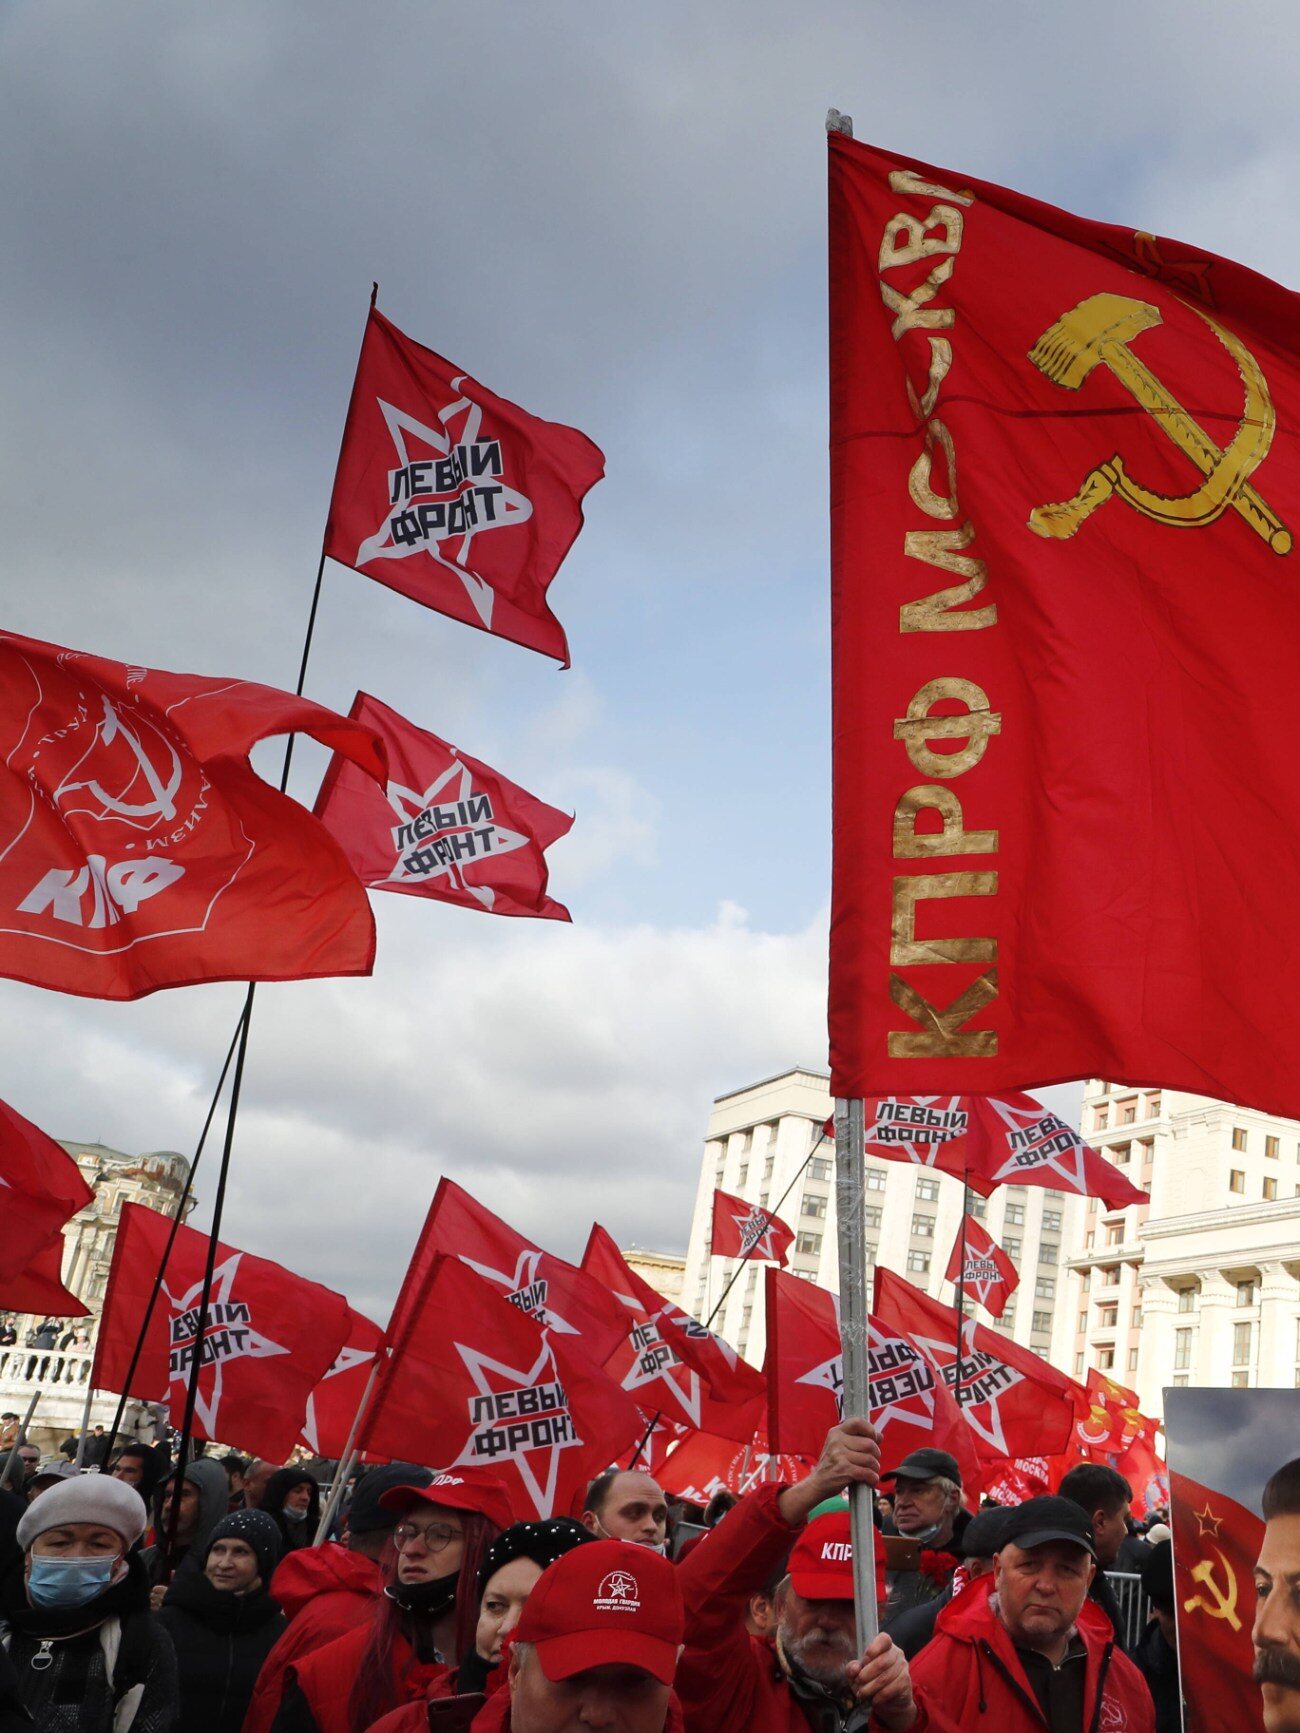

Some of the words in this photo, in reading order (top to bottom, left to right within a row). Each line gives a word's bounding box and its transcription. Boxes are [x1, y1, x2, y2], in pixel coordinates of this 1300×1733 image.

[391, 436, 503, 503] ЛЕВЫЙ
[391, 486, 503, 546] ФРОНТ
[397, 792, 493, 851] ЛЕВЫЙ
[888, 676, 1002, 1058] КПРФ
[876, 1102, 967, 1129] ЛЕВЫЙ
[966, 1260, 997, 1270] ЛЕВЫ
[172, 1299, 250, 1342] ЕВЫЙ
[472, 1383, 569, 1424] ЛЕВЫ
[953, 1364, 1013, 1408] РОНТ
[821, 1542, 853, 1561] КПР
